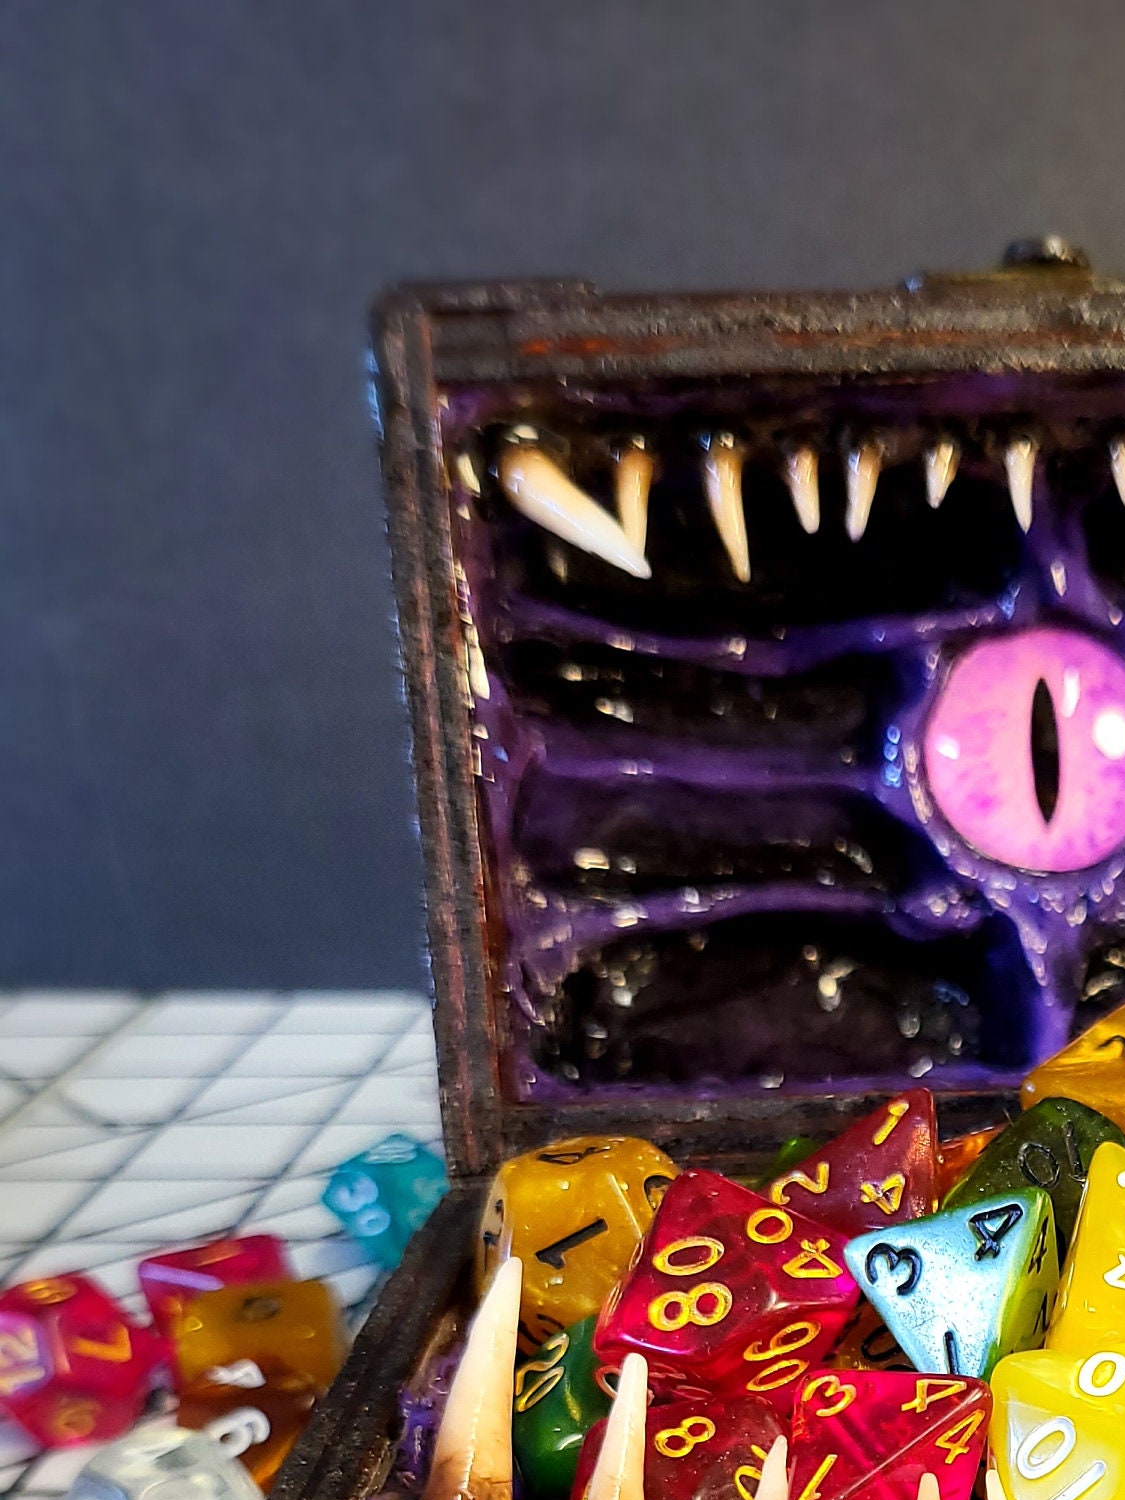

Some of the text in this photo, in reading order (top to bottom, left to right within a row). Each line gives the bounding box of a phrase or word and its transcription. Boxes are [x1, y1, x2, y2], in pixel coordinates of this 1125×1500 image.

[873, 1101, 910, 1145] 1
[770, 1161, 829, 1205] 2
[860, 1173, 906, 1215] 4
[535, 1217, 609, 1271] 1
[746, 1207, 844, 1279] 40
[967, 1202, 1024, 1262] 4
[647, 1236, 733, 1331] 80
[864, 1242, 923, 1297] 3
[802, 1375, 858, 1418] 3
[901, 1377, 967, 1414] 4
[654, 1415, 717, 1459] 8
[934, 1409, 987, 1465] 4
